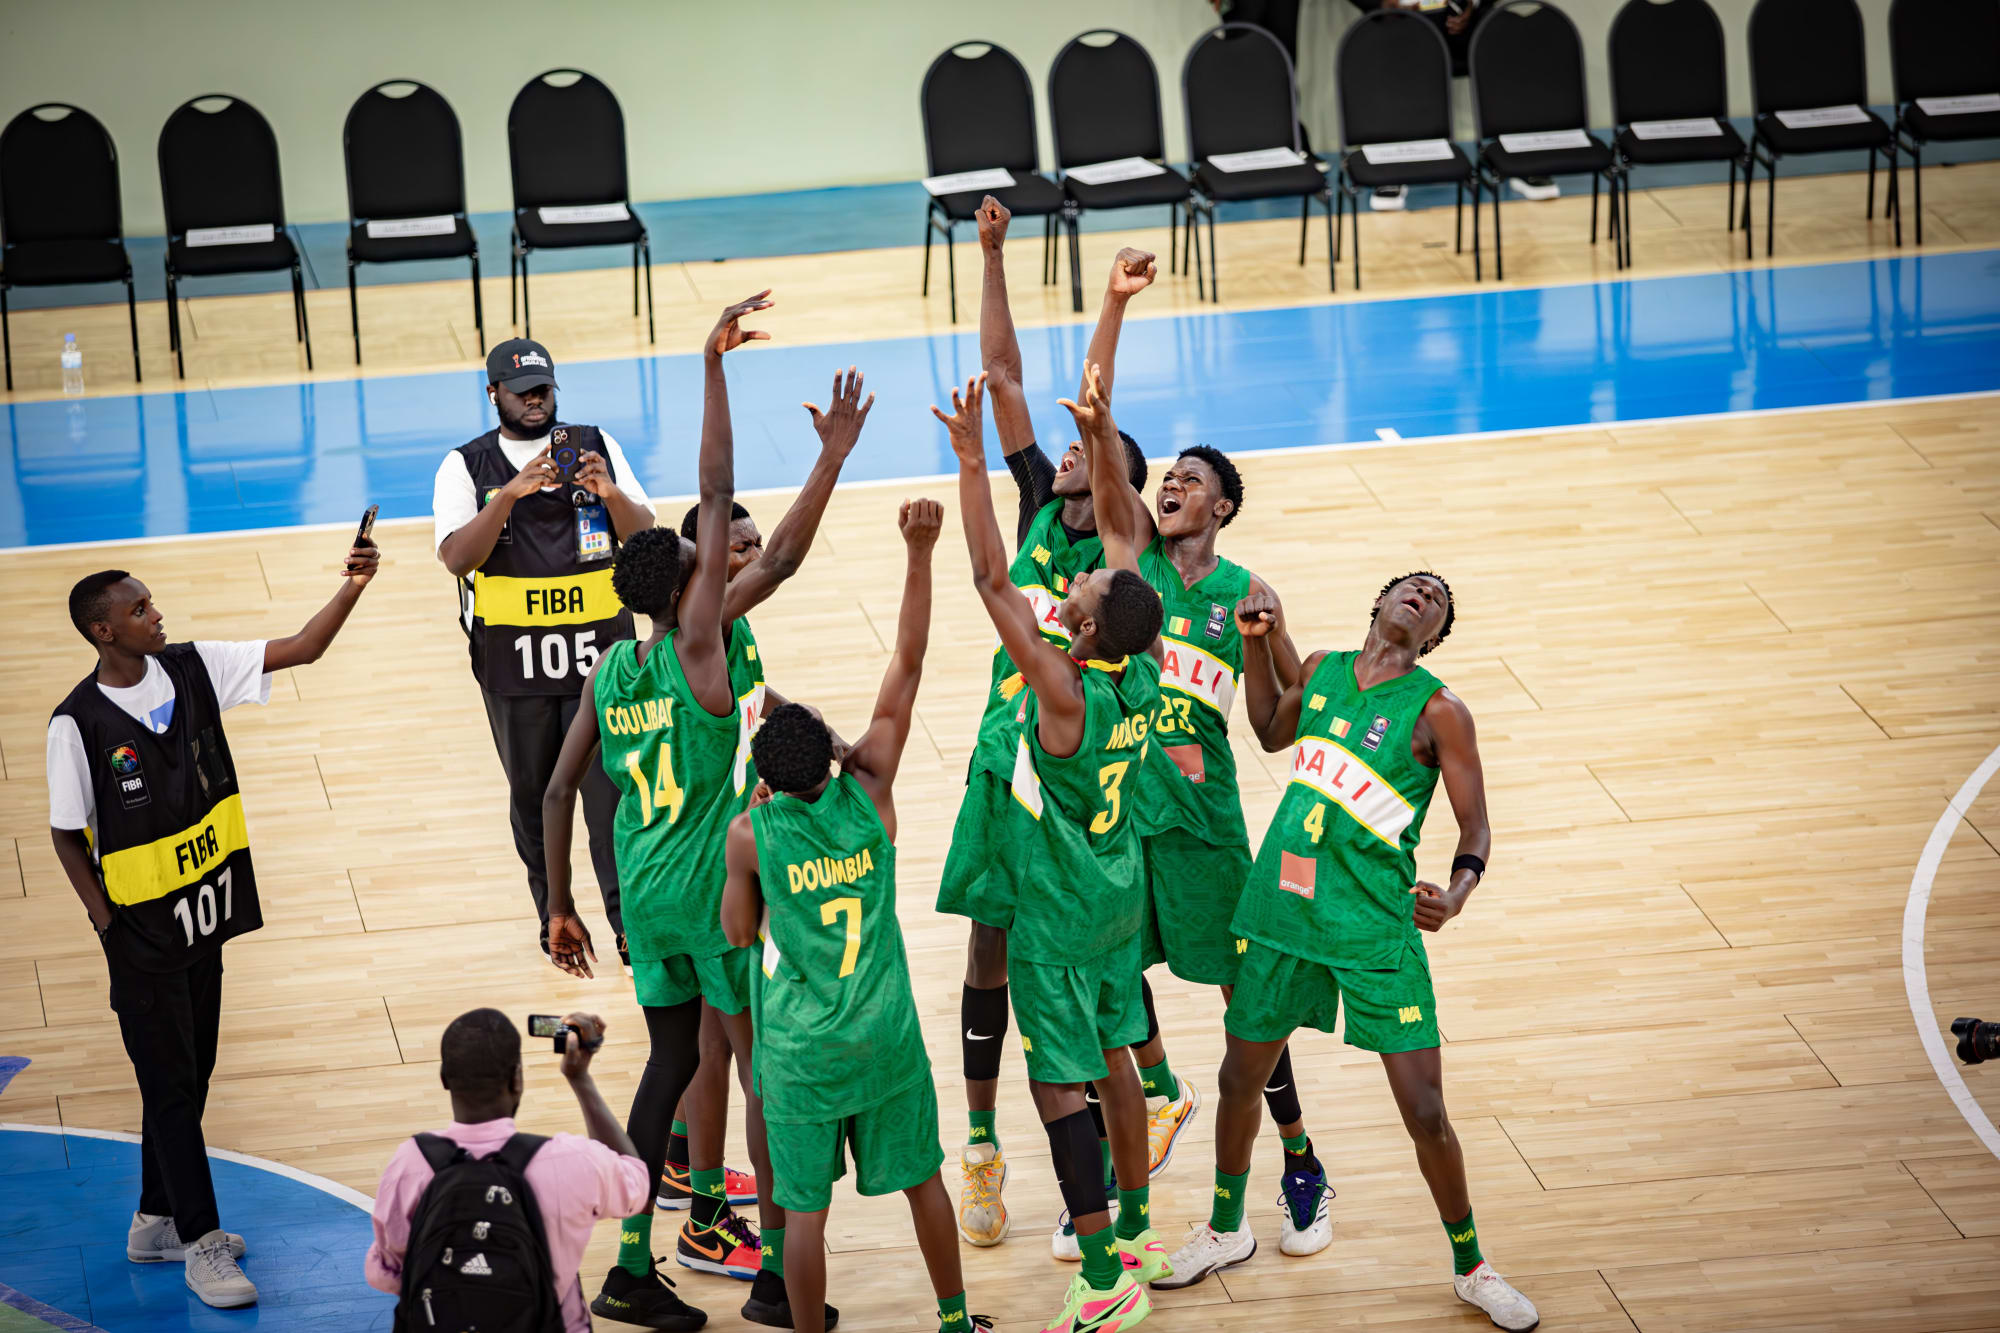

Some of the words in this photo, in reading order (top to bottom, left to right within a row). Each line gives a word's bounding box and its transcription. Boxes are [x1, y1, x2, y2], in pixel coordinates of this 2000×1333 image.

[526, 586, 584, 615] FIBA
[514, 630, 601, 679] 105
[1162, 650, 1222, 694] ALI
[1106, 709, 1155, 750] MAG
[1156, 694, 1196, 735] 23
[122, 778, 143, 792] FIBA
[625, 743, 684, 826] 14
[1303, 802, 1326, 844] 4
[175, 824, 219, 876] FIBA
[787, 848, 874, 894] DOUMBIA
[173, 866, 232, 947] 107
[820, 897, 862, 978] 7
[1398, 1006, 1422, 1024] WA
